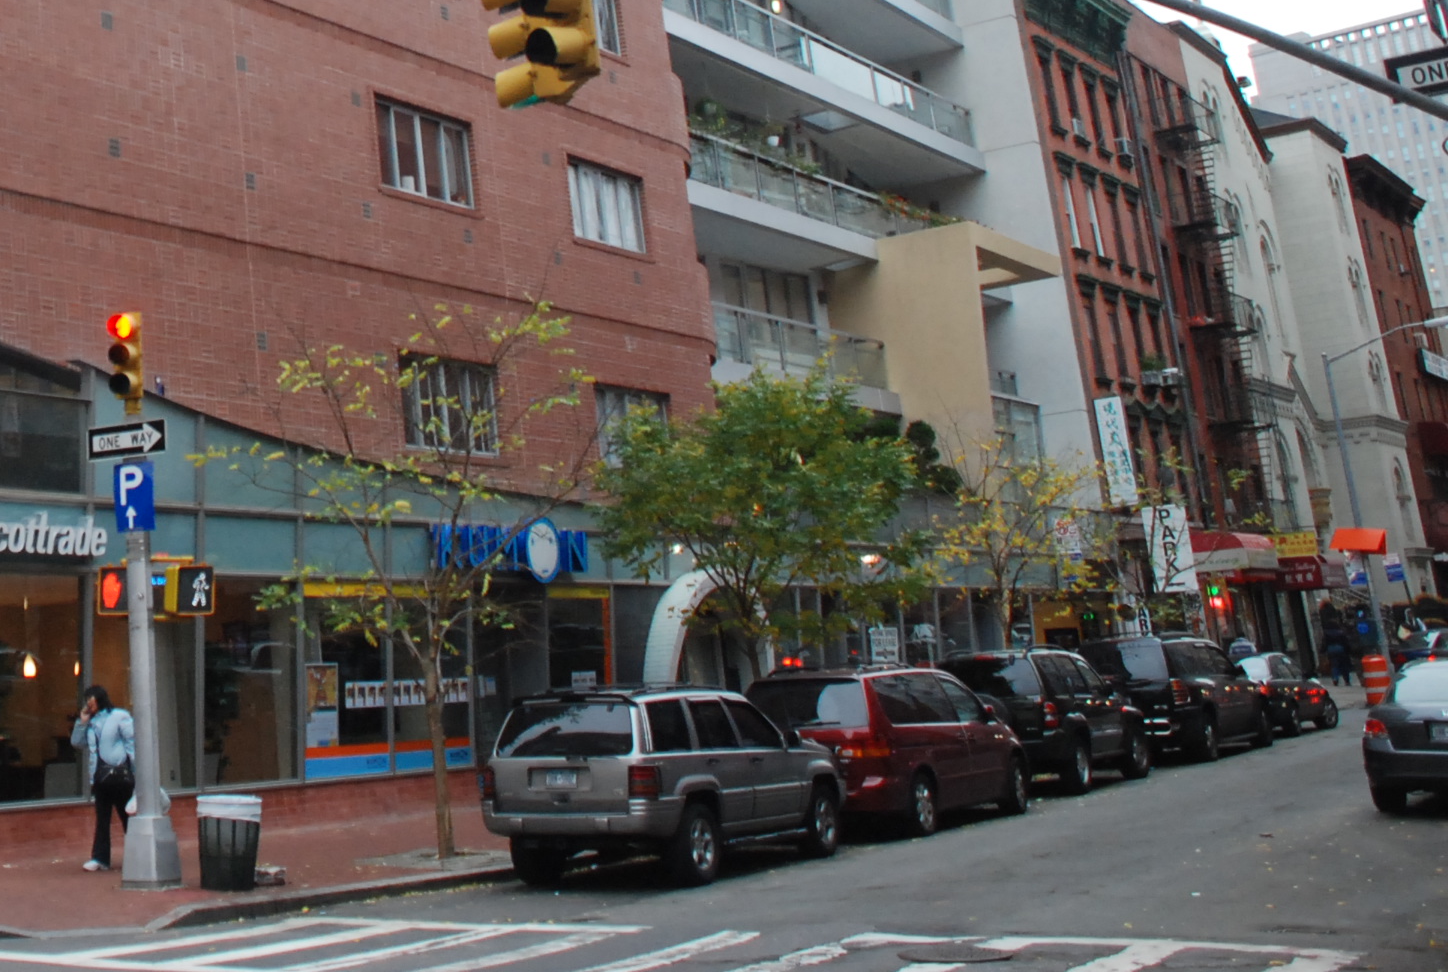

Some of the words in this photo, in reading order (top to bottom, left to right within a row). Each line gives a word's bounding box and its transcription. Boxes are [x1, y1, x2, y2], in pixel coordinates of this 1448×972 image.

[99, 435, 120, 450] ONE
[130, 430, 153, 444] WAY
[119, 465, 144, 506] P
[436, 518, 588, 583] KUMON
